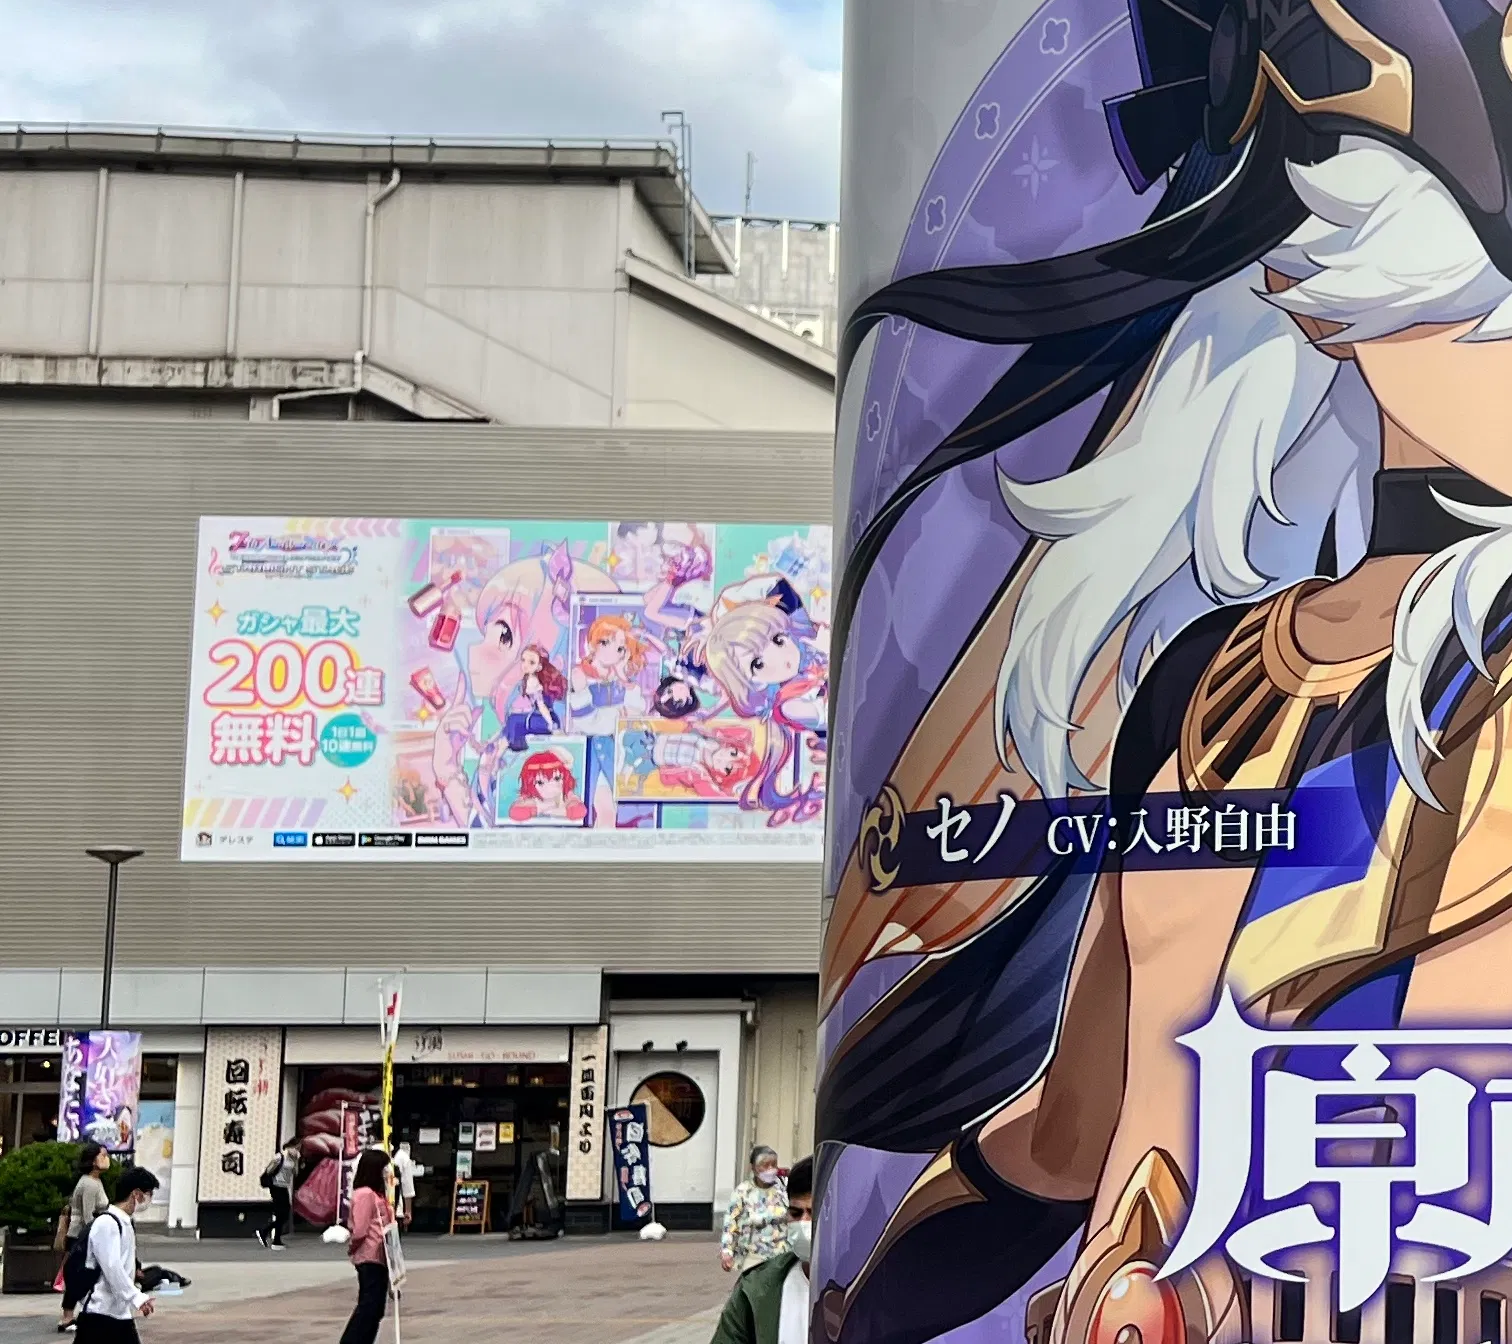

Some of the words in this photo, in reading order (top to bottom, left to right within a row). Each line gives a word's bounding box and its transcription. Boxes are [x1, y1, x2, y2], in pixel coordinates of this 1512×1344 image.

[237, 605, 361, 638] ガシャ最大
[203, 639, 386, 708] 200連
[210, 711, 319, 766] 無料
[925, 794, 1017, 864] セノ
[221, 1058, 250, 1176] 回転寿司
